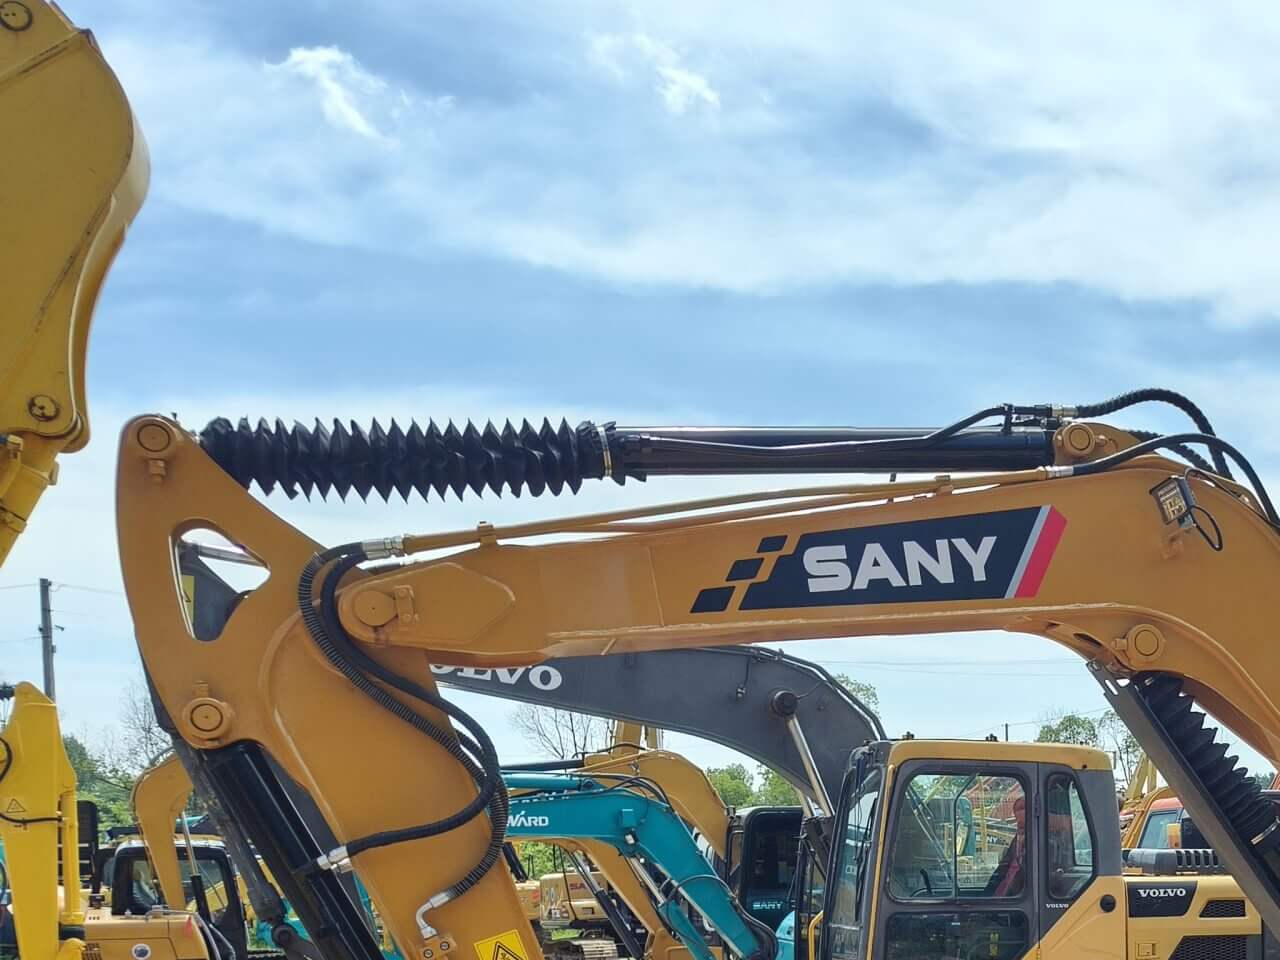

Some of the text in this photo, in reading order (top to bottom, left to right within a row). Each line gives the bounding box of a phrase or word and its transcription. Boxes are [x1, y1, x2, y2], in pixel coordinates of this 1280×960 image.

[802, 535, 998, 593] SANY
[1138, 887, 1186, 898] VOLVO
[753, 901, 784, 910] SANY
